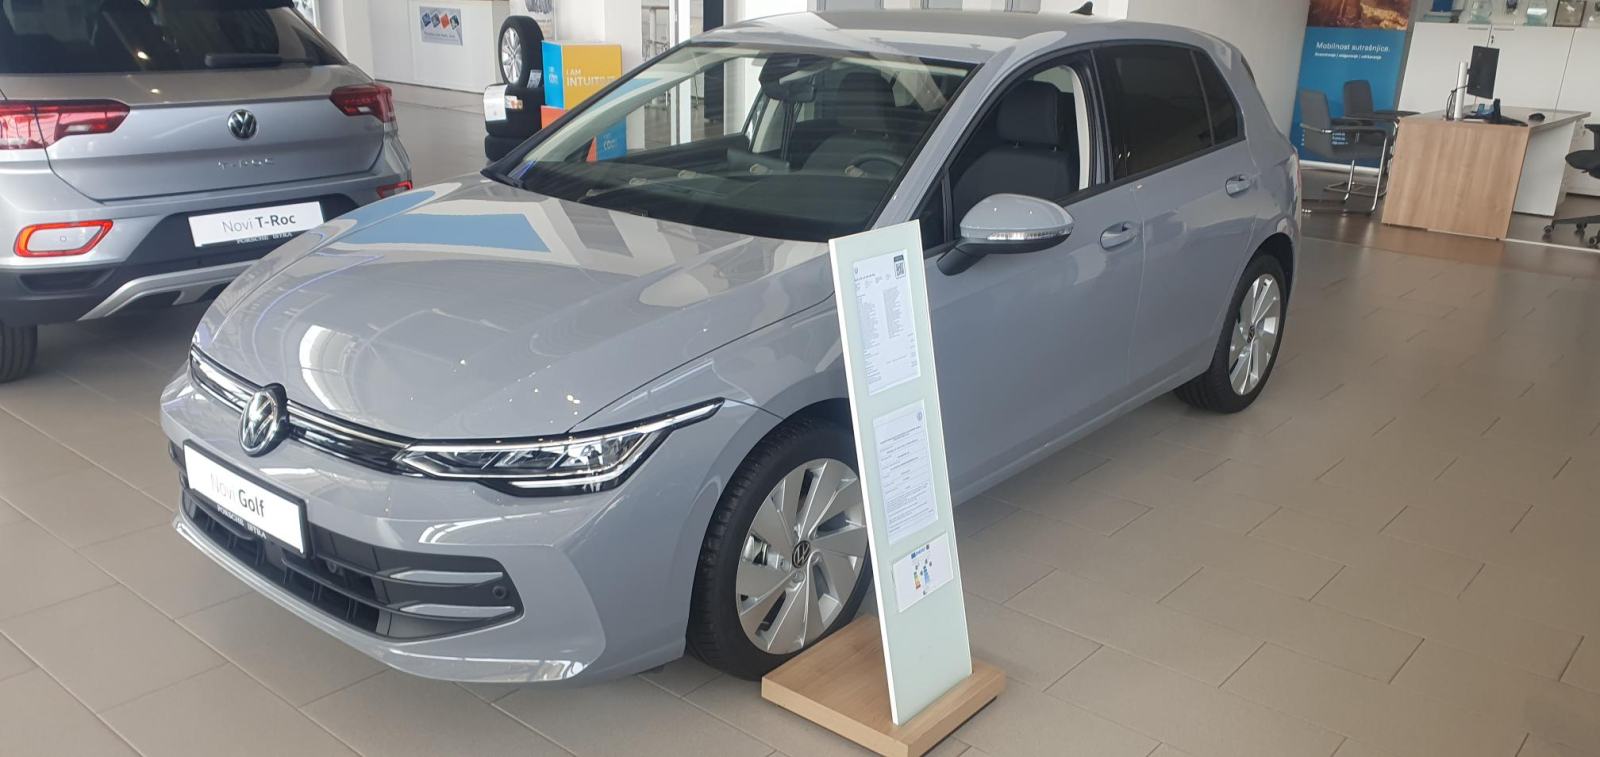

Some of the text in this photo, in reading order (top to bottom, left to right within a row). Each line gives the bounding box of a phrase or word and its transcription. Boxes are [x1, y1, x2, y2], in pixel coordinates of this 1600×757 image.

[1316, 41, 1350, 51] Mobilnost
[222, 214, 296, 233] Novi T-Roc
[210, 473, 265, 518] Novi Golf
